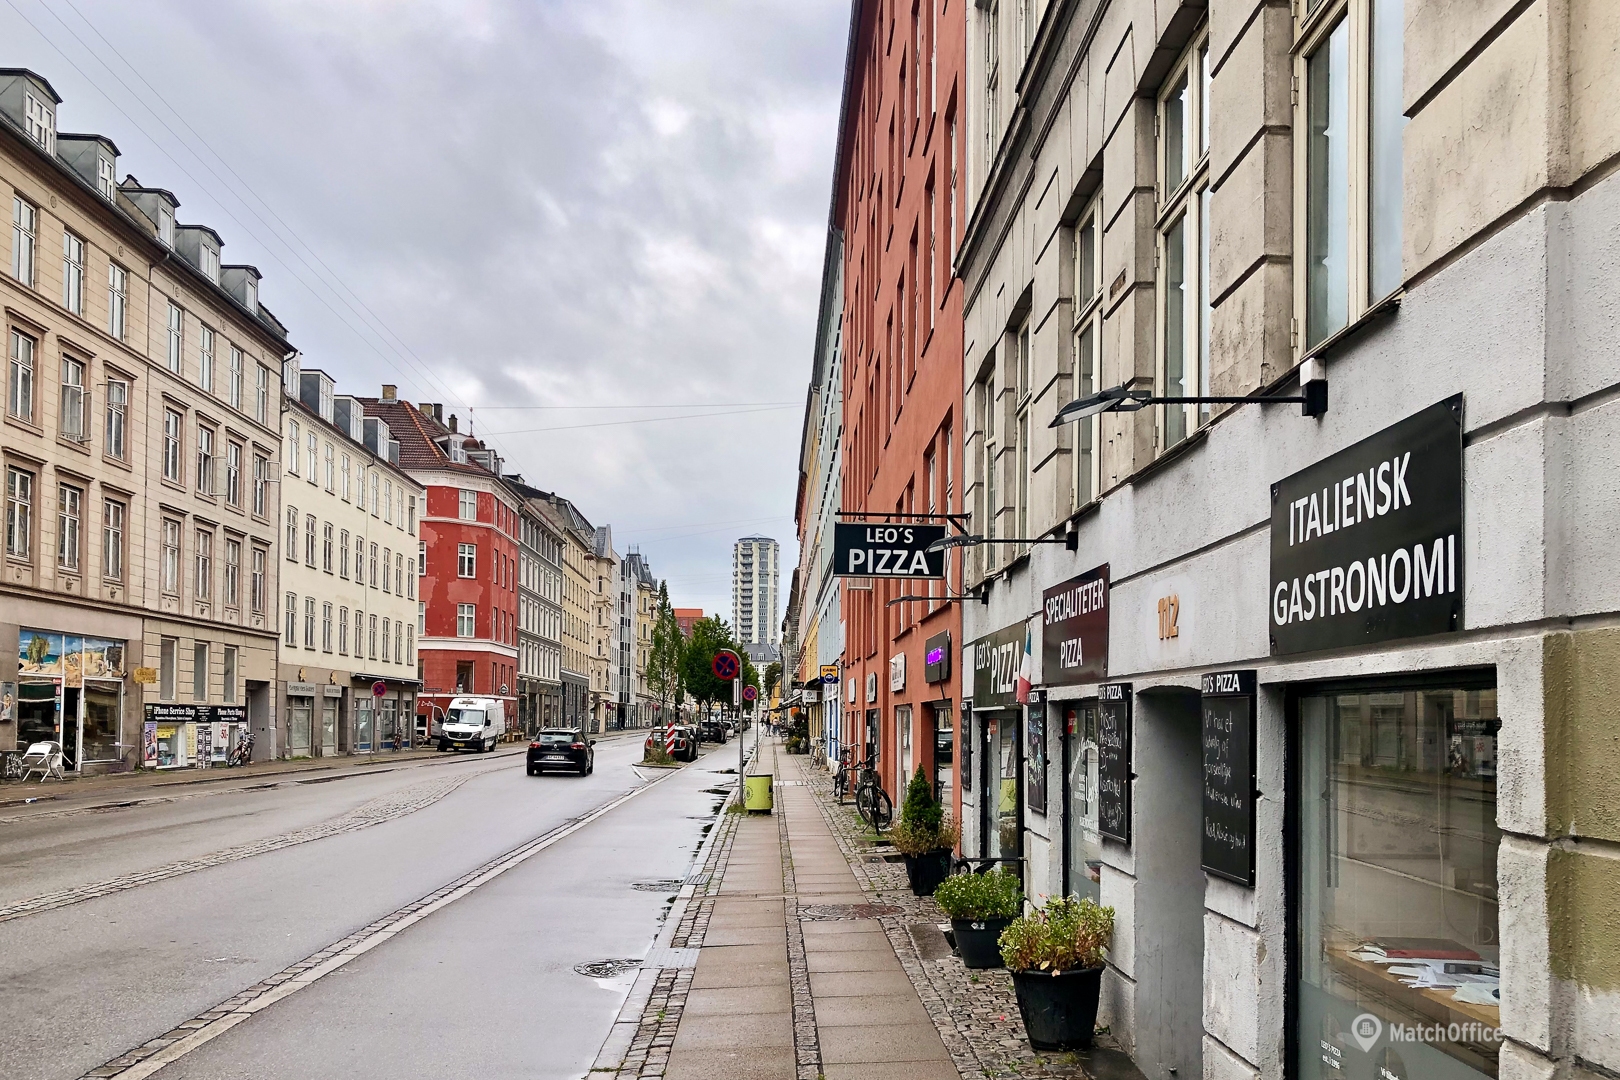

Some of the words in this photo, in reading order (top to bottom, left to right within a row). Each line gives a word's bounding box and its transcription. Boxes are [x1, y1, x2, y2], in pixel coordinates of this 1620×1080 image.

[1289, 451, 1412, 547] ITALIENSK
[866, 527, 914, 544] LEO'S
[848, 548, 930, 575] PIZZA
[1273, 534, 1455, 626] GASTRONOMI
[1045, 578, 1105, 626] SPECIALITETER
[1157, 594, 1180, 640] 112
[976, 639, 991, 671] LEO'S
[990, 640, 1020, 695] PIZZA
[1060, 637, 1083, 669] PIZZA
[1106, 685, 1123, 700] PIZZA
[1216, 673, 1240, 692] PIZZA
[169, 706, 185, 715] Service
[185, 707, 196, 718] Shop
